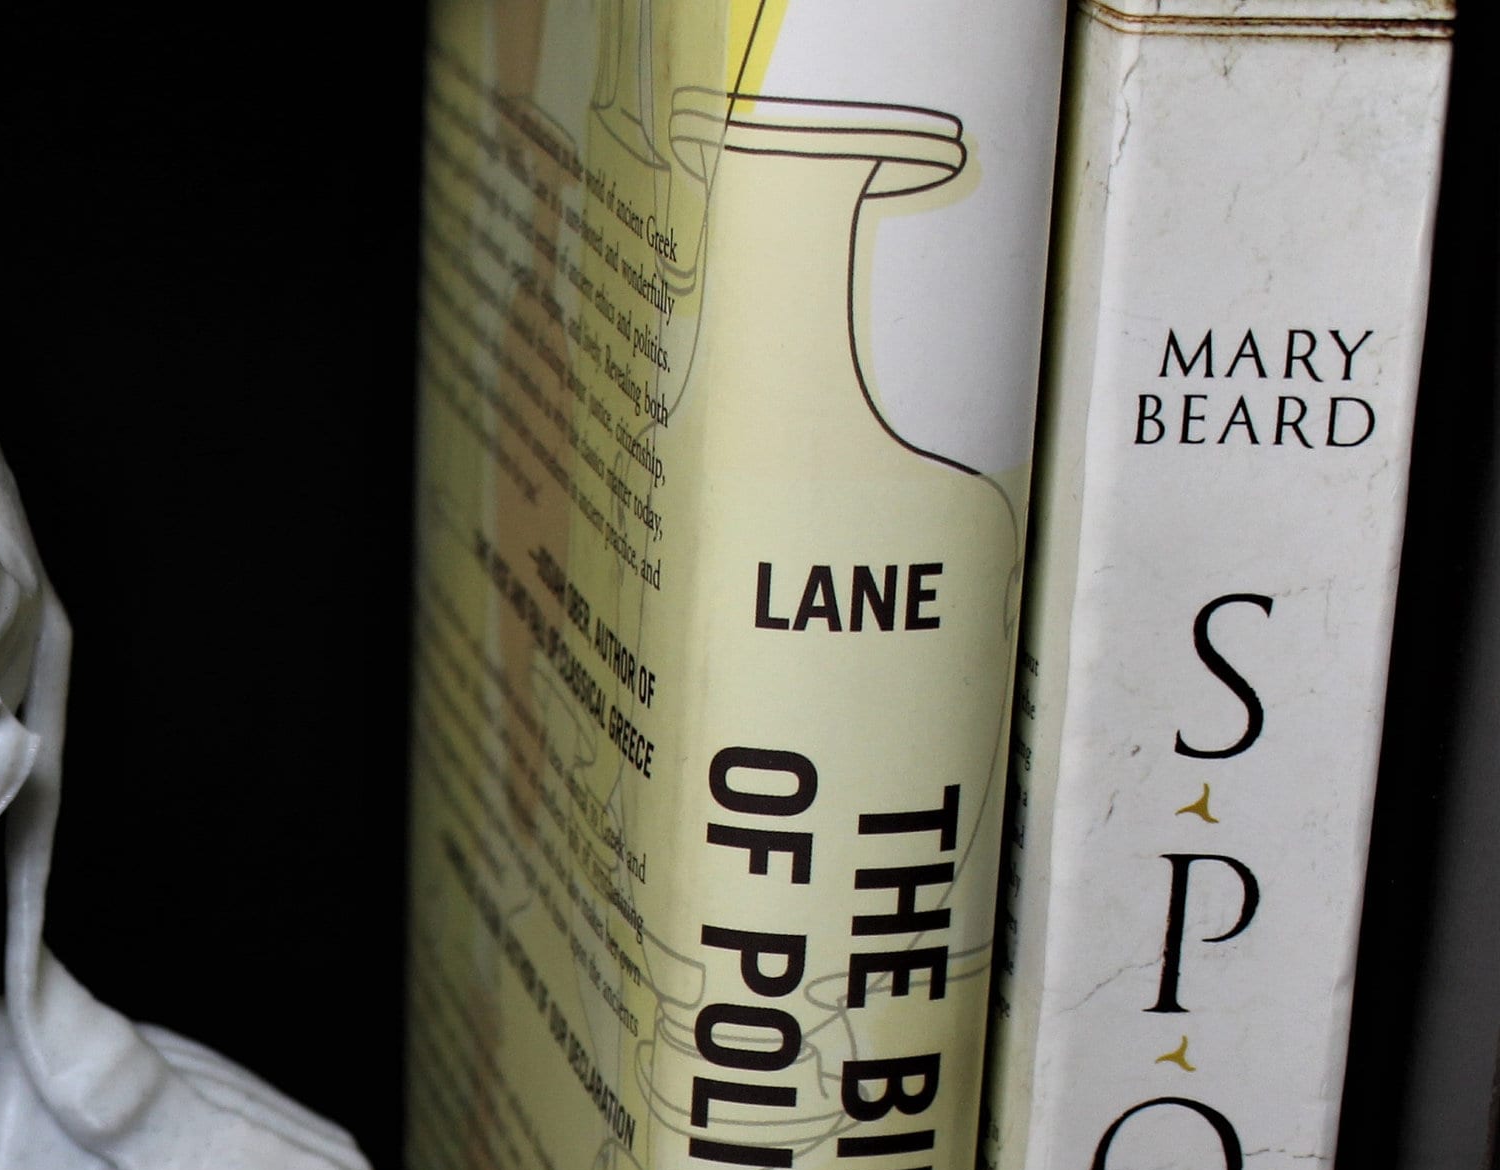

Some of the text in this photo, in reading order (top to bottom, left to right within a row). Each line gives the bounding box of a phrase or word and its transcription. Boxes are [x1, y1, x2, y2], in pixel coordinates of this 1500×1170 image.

[616, 199, 644, 240] ancient
[646, 215, 678, 263] Greek
[621, 263, 675, 326] wonderfully
[617, 309, 632, 342] and
[633, 323, 671, 374] politics.
[1158, 328, 1373, 382] MARY
[605, 343, 642, 417] Revealing
[645, 380, 669, 428] both
[615, 416, 666, 488] citizenship,
[1134, 394, 1376, 449] BEARD
[633, 493, 663, 543] today,
[605, 521, 638, 576] practice,
[641, 558, 661, 592] and
[754, 561, 943, 632] LANE
[594, 615, 635, 695] AUTHOR
[638, 664, 656, 709] OF
[608, 704, 655, 780] GREECE
[706, 746, 818, 884] OF
[626, 852, 647, 885] and
[846, 784, 961, 1009] THE
[602, 980, 639, 1039] ancients
[568, 1030, 637, 1152] DECLARATION
